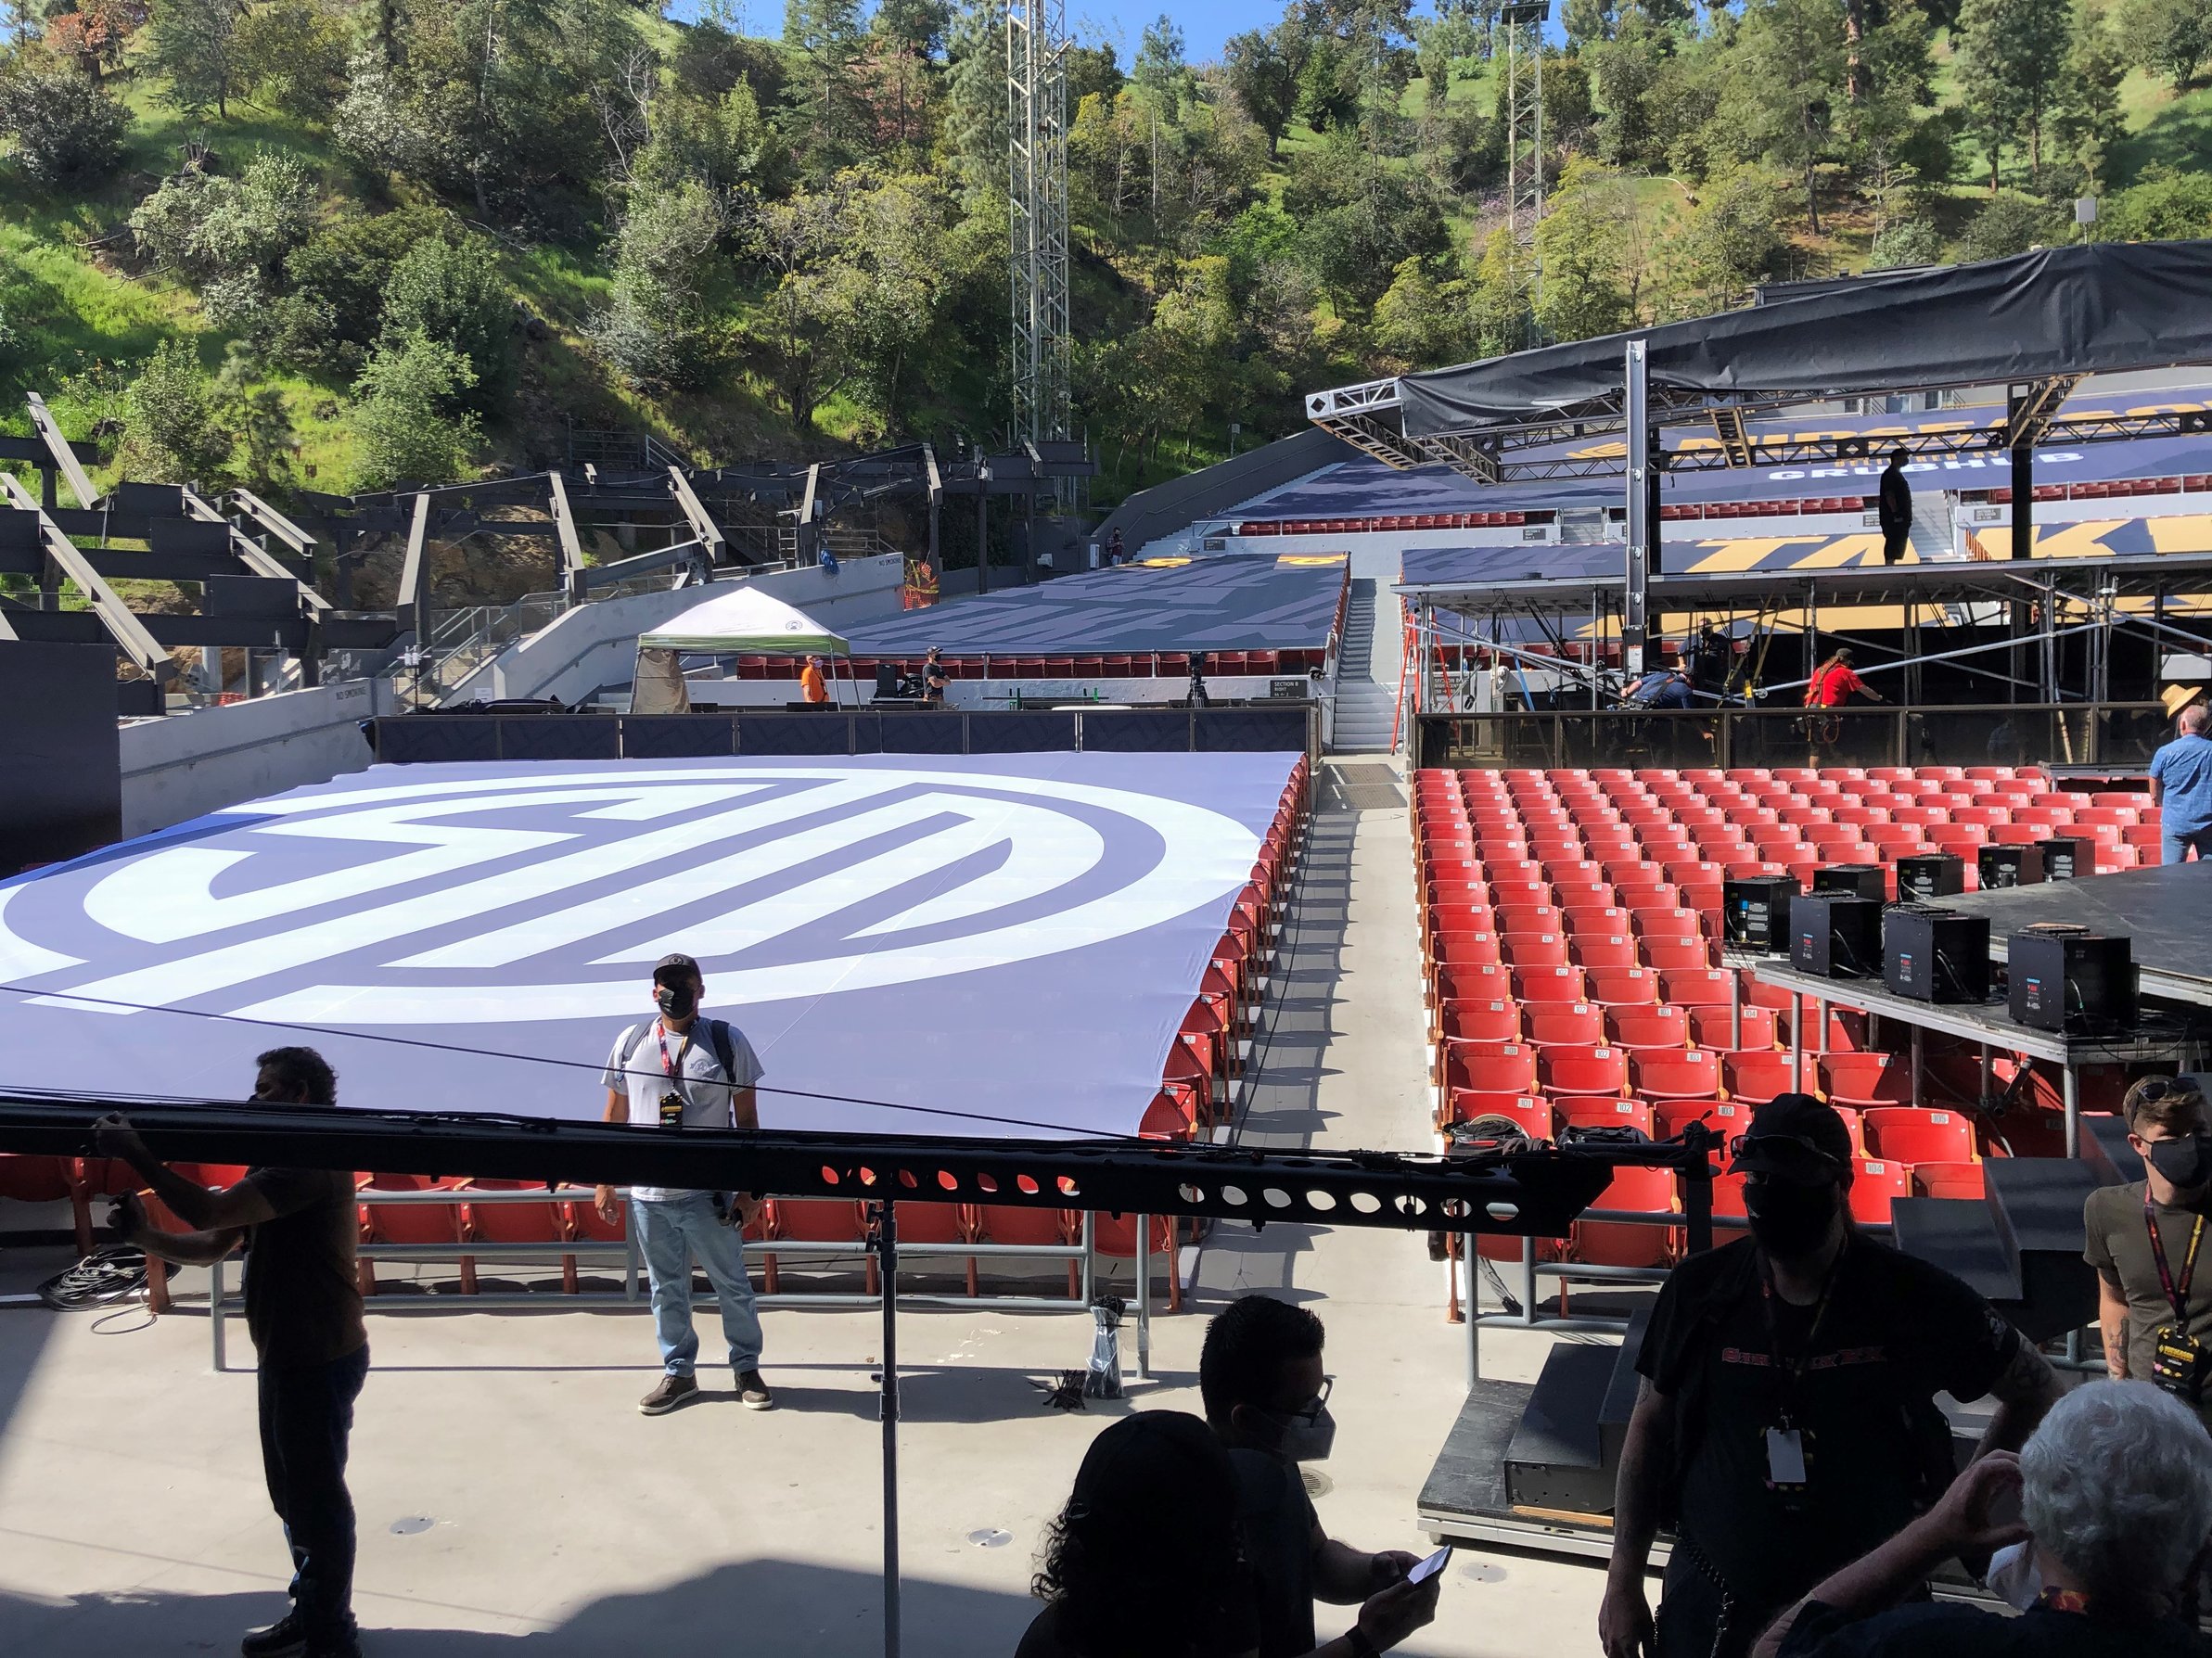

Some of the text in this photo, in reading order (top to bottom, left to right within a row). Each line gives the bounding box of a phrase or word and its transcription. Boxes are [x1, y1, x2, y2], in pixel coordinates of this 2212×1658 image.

[1658, 1008, 1671, 1016] 103
[1745, 1010, 1758, 1018] 104
[1617, 1103, 1632, 1112] 102
[1867, 1164, 1884, 1172] 104
